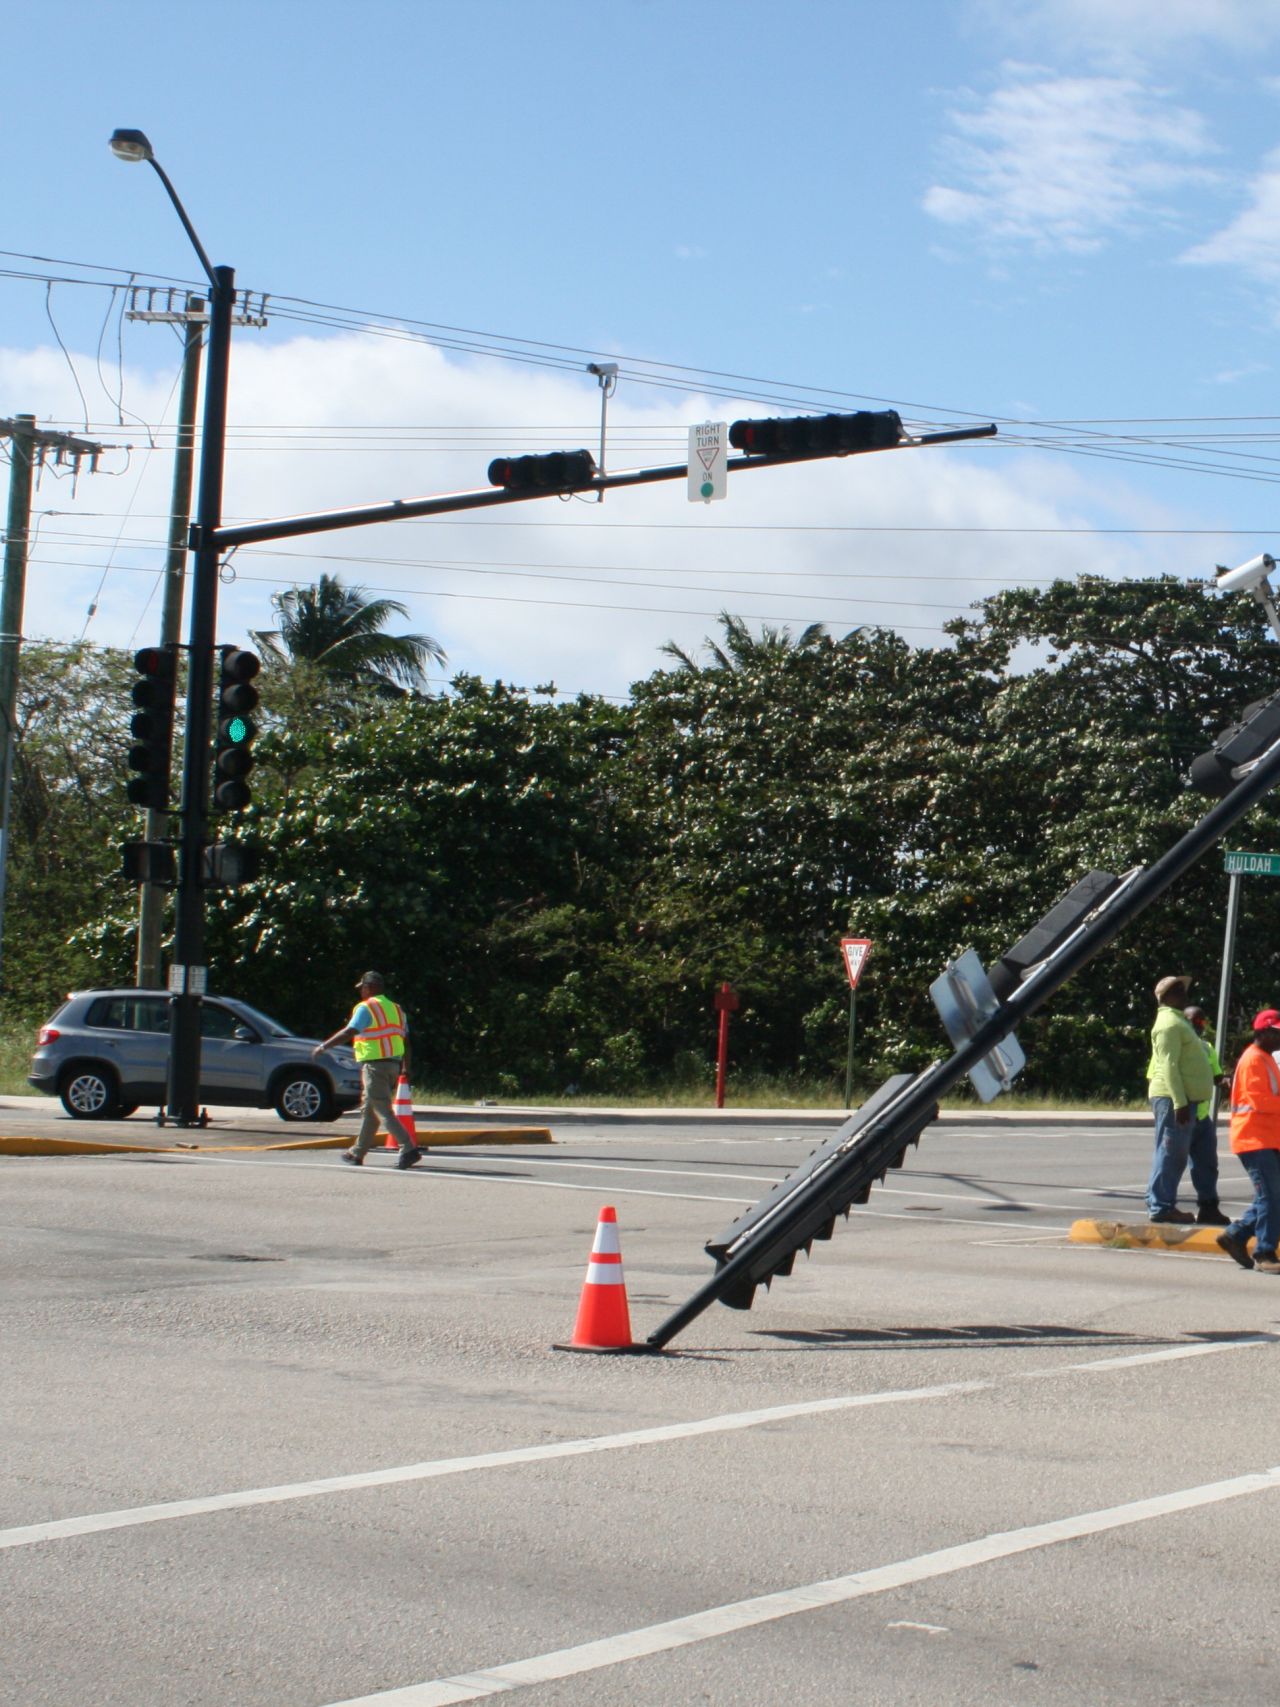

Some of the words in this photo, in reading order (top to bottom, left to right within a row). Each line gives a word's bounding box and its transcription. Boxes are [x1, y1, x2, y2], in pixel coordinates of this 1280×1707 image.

[696, 424, 720, 437] RIGHT
[697, 436, 720, 447] TURN
[702, 472, 713, 481] ON
[1228, 855, 1271, 873] HULDAH
[848, 946, 863, 956] GIVE
